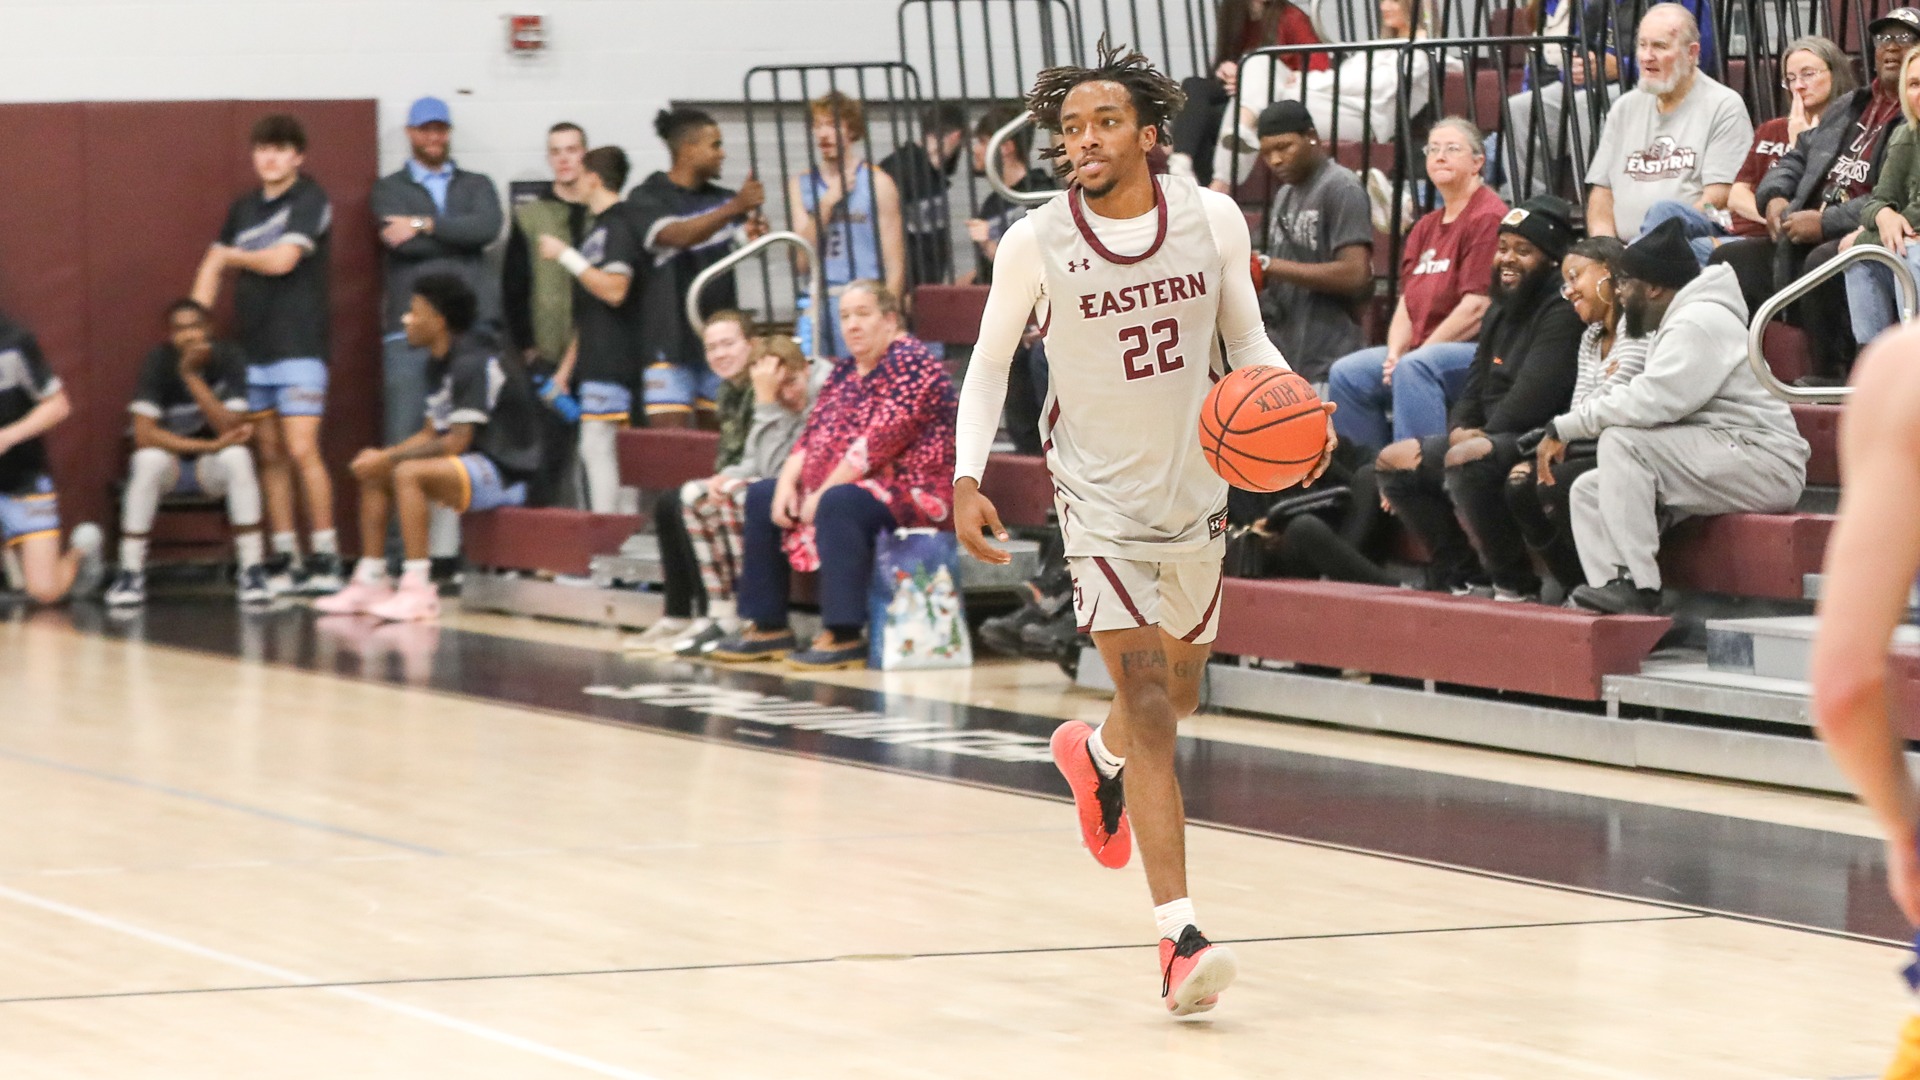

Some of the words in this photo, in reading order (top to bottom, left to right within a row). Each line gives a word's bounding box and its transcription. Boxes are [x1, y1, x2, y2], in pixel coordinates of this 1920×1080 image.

[1079, 271, 1207, 319] EASTERN
[1118, 317, 1185, 381] 22
[1254, 382, 1300, 413] ROCK
